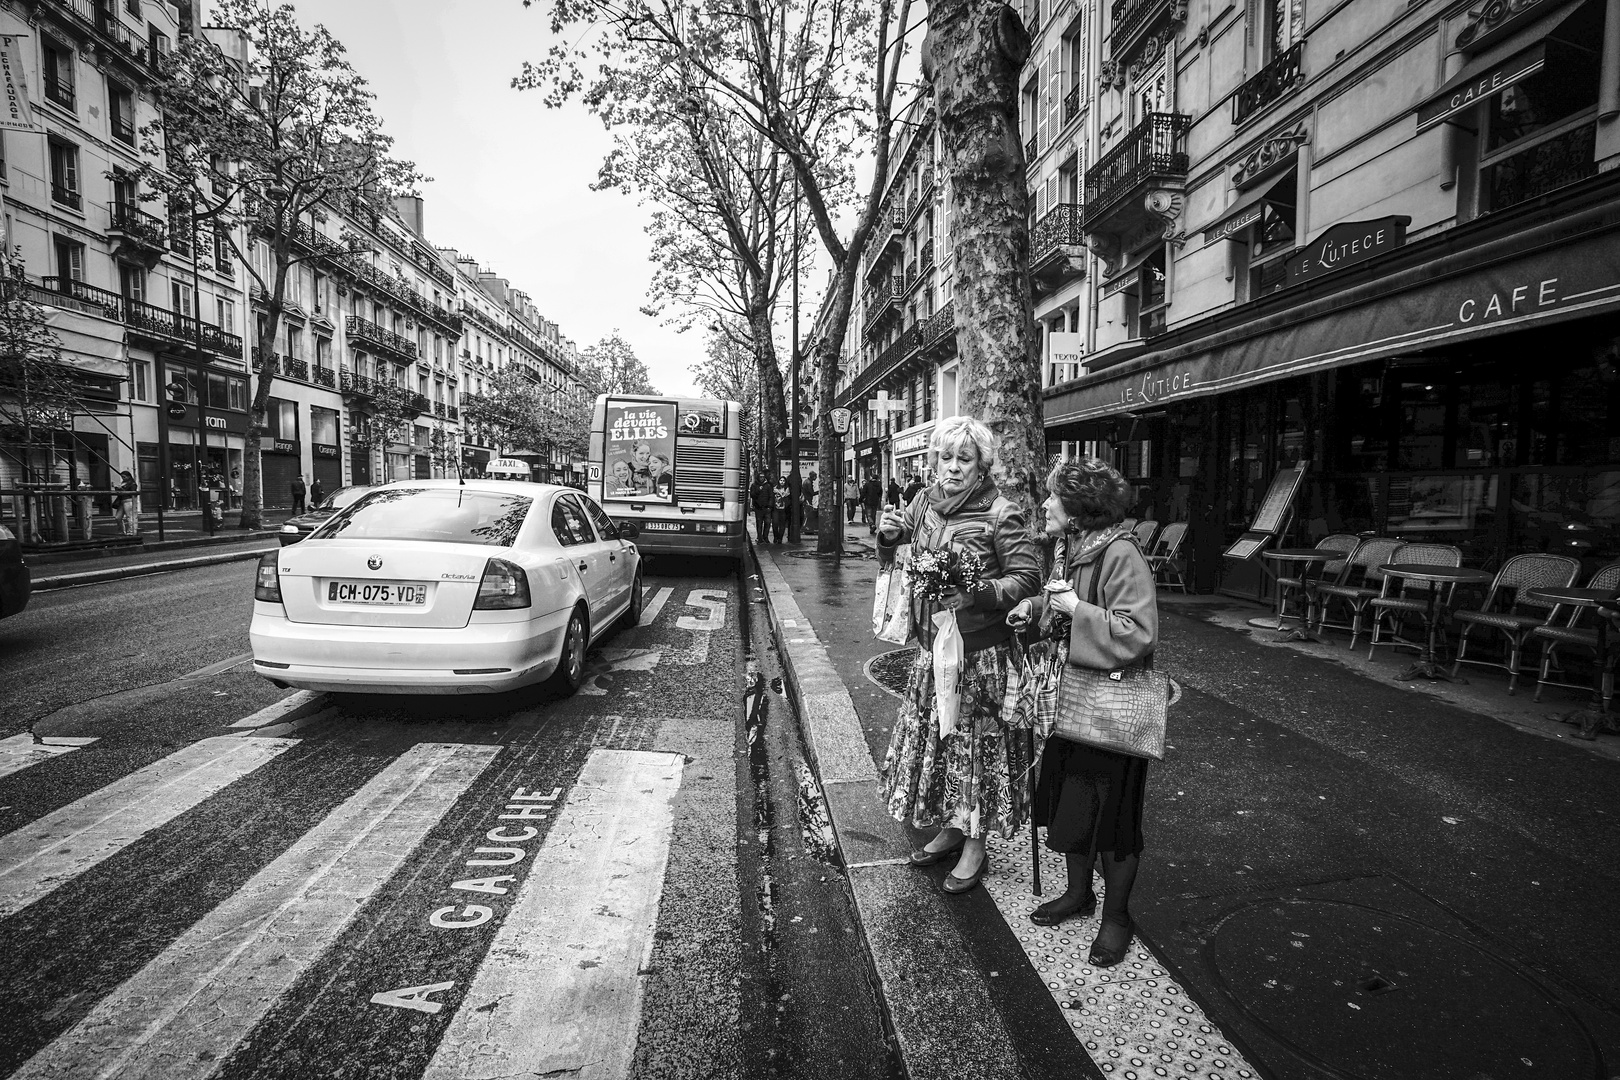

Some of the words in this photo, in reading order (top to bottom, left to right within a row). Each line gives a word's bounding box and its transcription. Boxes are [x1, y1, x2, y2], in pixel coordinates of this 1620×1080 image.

[1, 52, 18, 119] ECHAFAUDAGE
[1450, 71, 1502, 108] CAFE
[1212, 229, 1220, 240] LE
[1222, 213, 1250, 234] LUTECE
[1294, 259, 1309, 276] LE
[1113, 276, 1129, 291] CAFE
[1459, 278, 1558, 323] CAFE
[1054, 353, 1078, 361] TEXTO
[1121, 387, 1133, 404] LE
[624, 411, 636, 420] la
[639, 409, 656, 419] vie
[198, 416, 227, 429] ram
[613, 416, 662, 429] devant
[610, 426, 668, 441] ELLES
[275, 441, 293, 452] range
[319, 445, 337, 456] Orange
[499, 460, 516, 468] TAXI
[590, 467, 599, 478] 70
[659, 485, 669, 497] 3
[339, 584, 415, 602] CM-075-VD
[429, 787, 563, 929] GAUCHE
